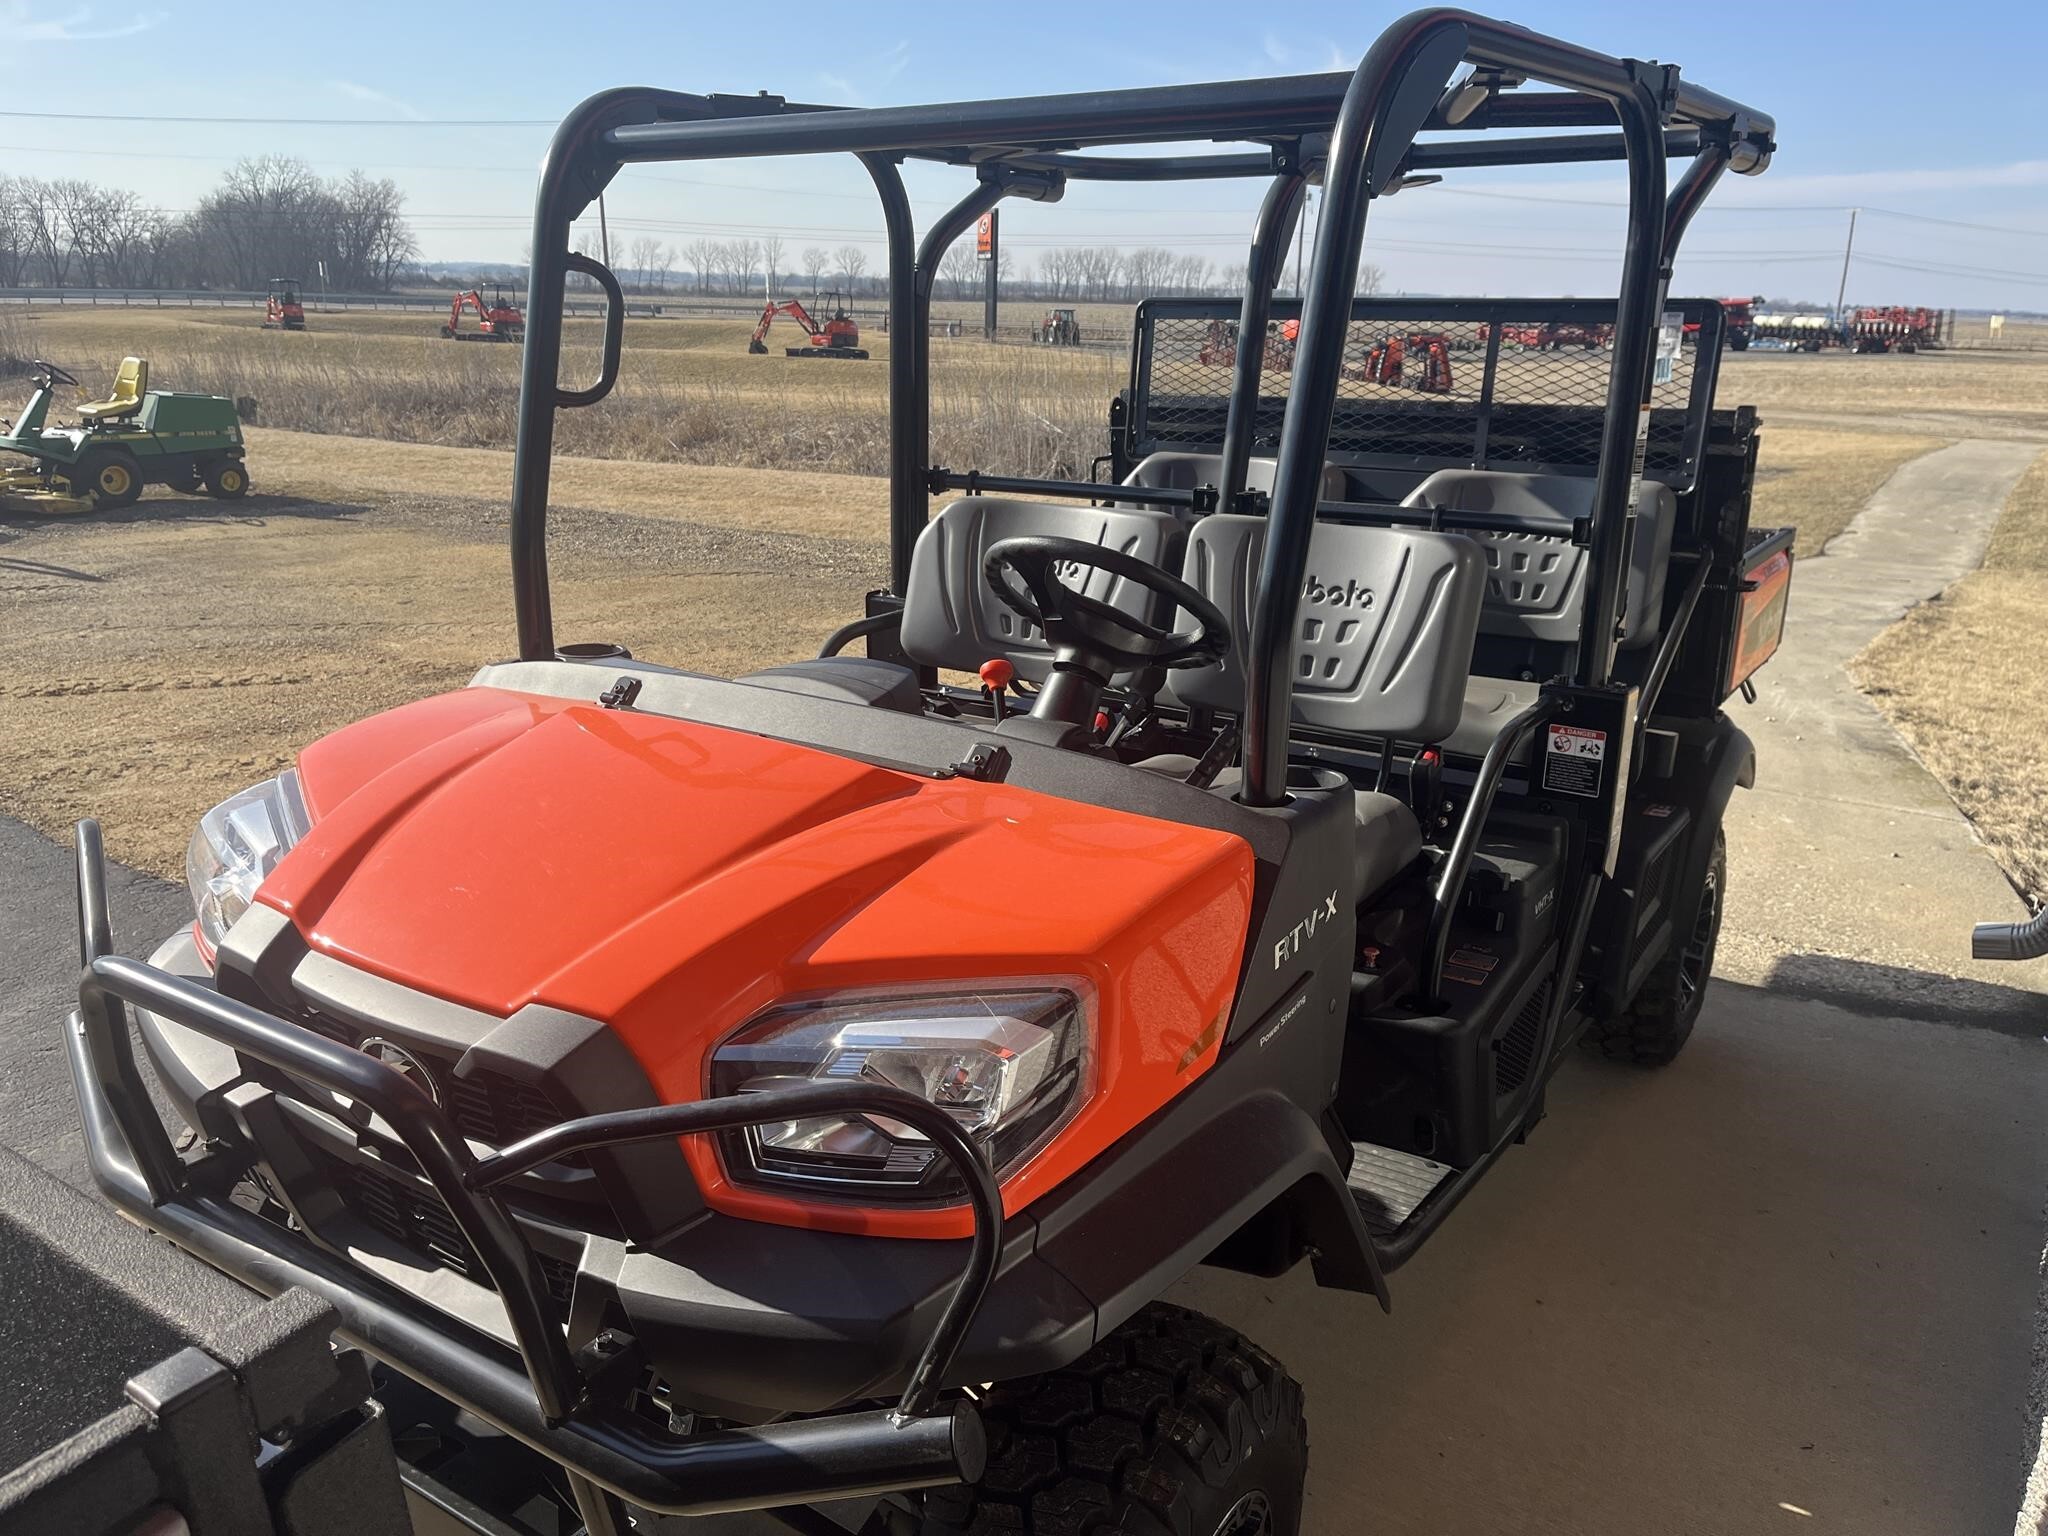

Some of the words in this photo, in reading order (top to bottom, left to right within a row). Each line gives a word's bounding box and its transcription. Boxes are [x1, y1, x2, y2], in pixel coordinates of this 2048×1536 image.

[1302, 575, 1376, 611] bota
[1567, 728, 1597, 738] DANGER
[1274, 889, 1338, 970] RTV-X
[1260, 1022, 1280, 1047] Power
[1281, 995, 1306, 1026] Steering
